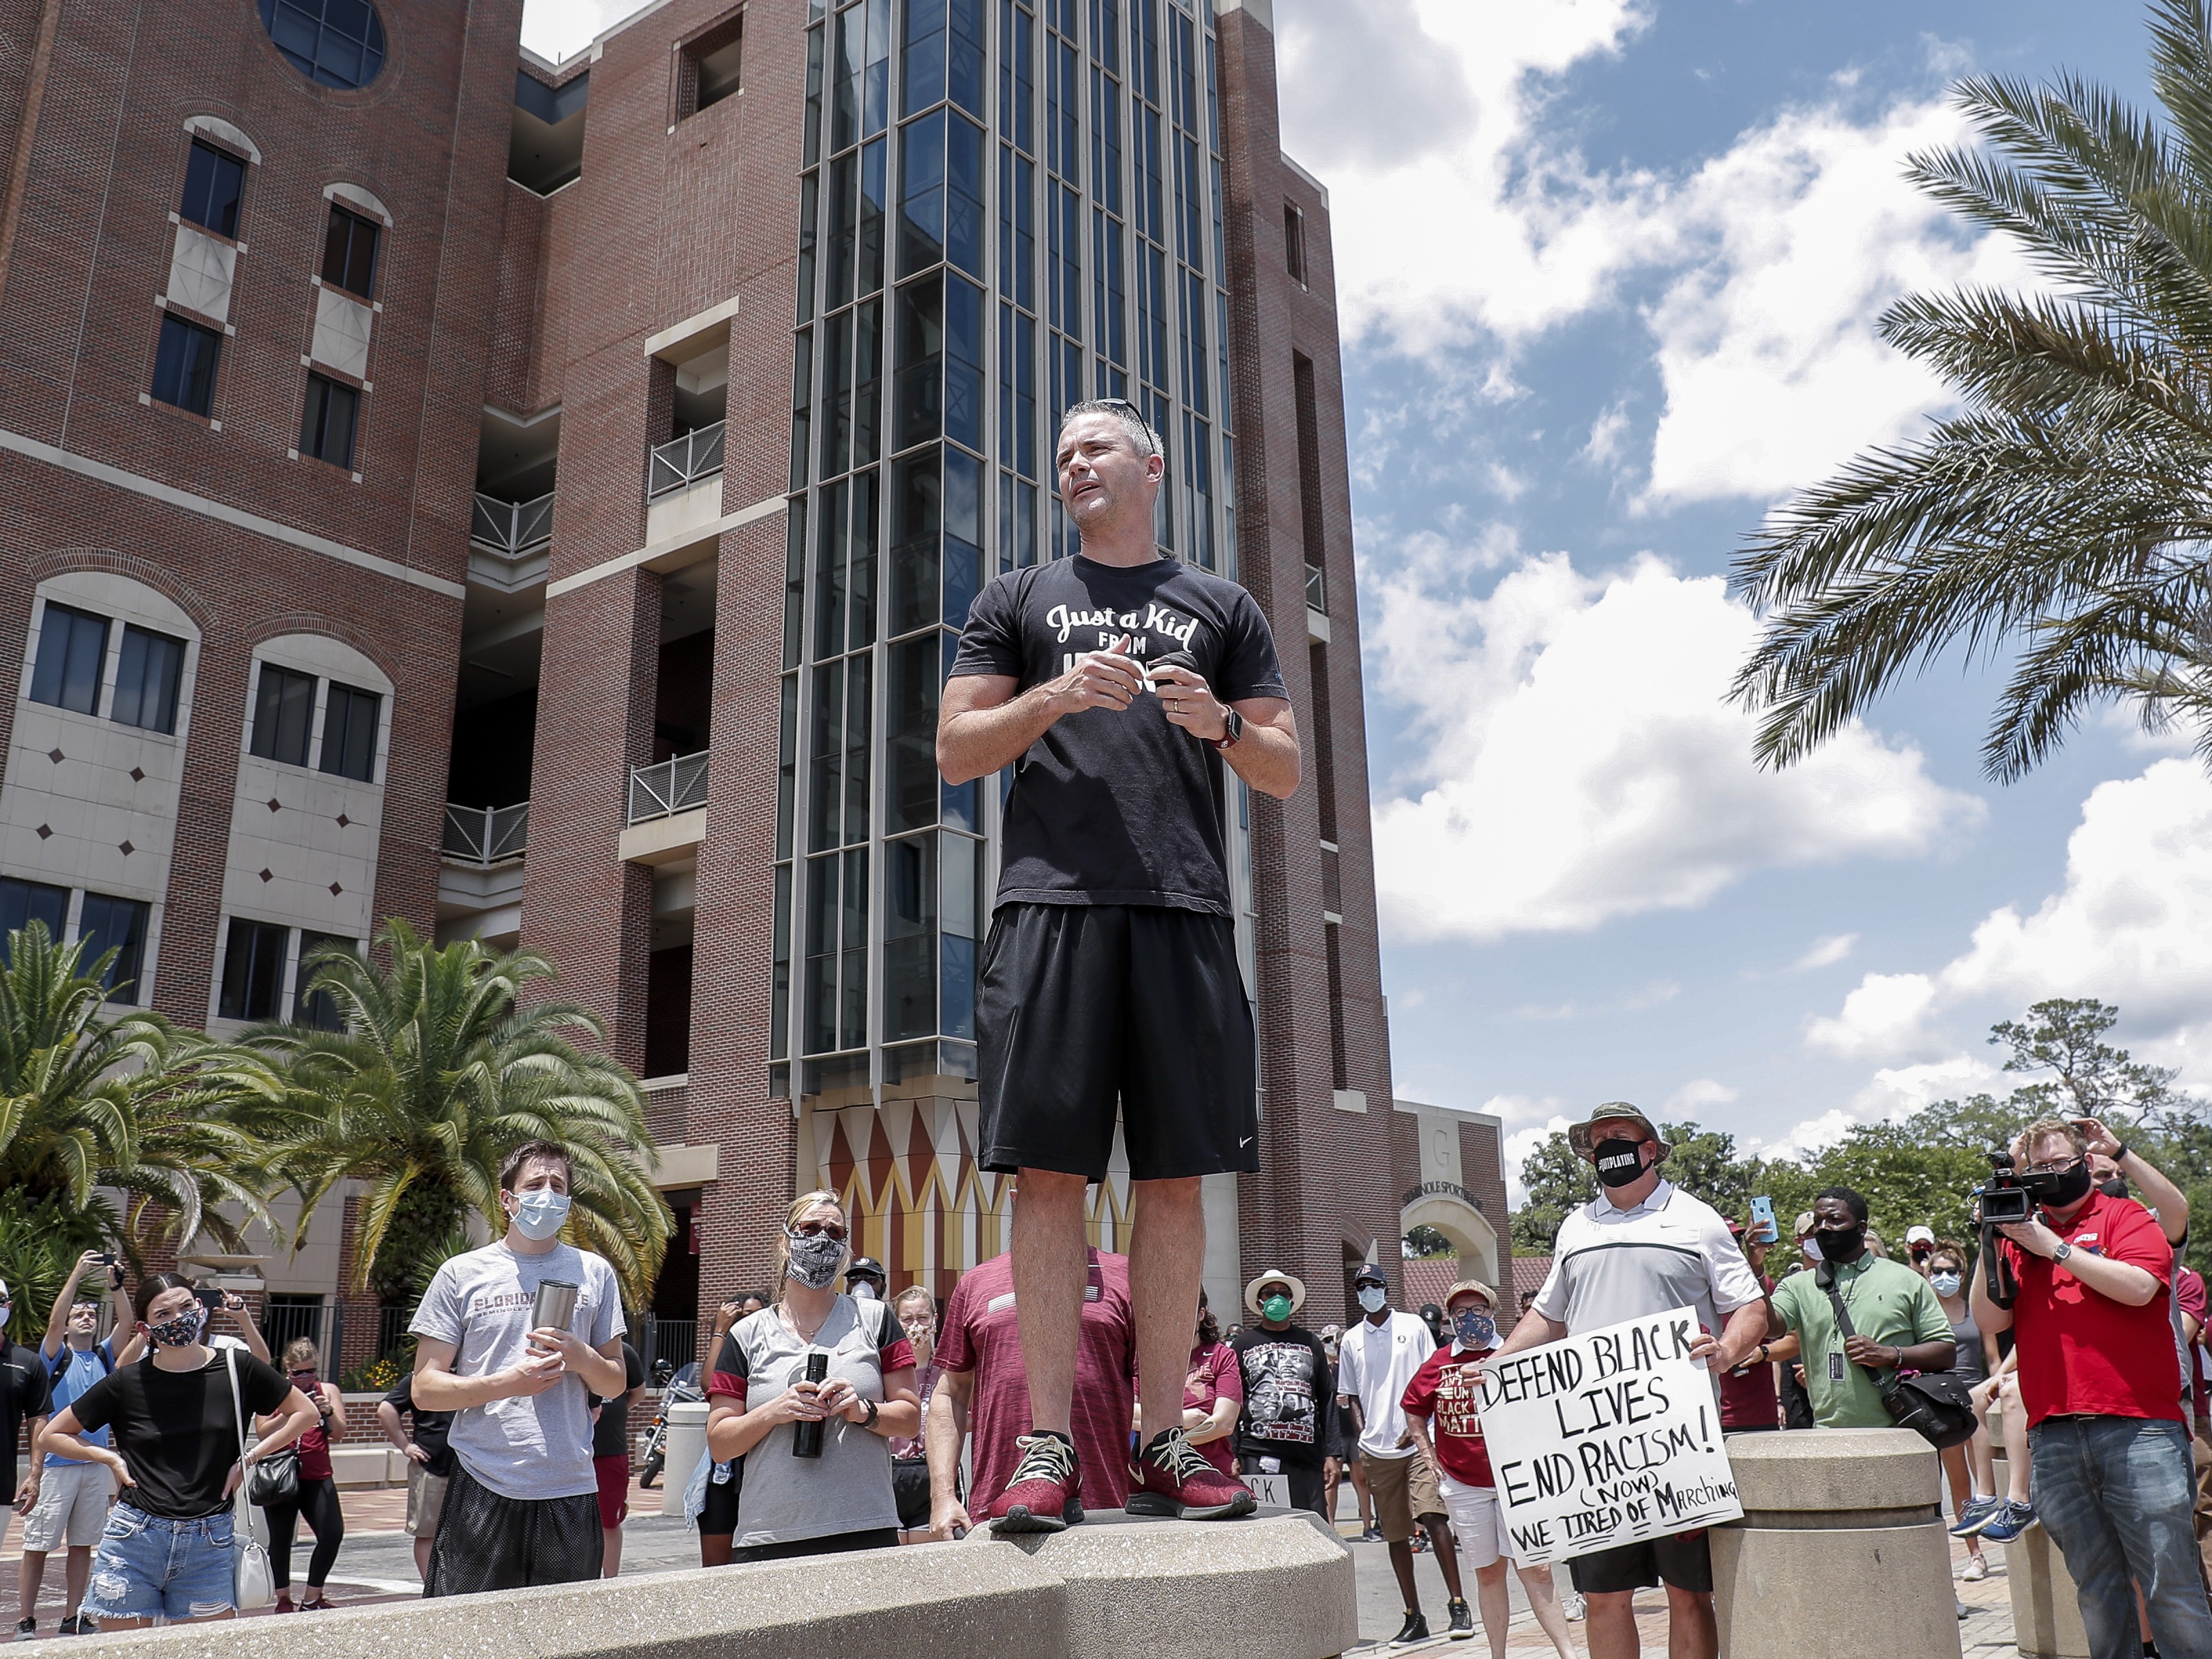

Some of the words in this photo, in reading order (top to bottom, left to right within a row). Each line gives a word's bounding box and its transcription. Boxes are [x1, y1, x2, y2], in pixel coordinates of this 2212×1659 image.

[1046, 603, 1116, 644] Just
[1119, 612, 1141, 630] a
[1142, 603, 1200, 653] Kid
[474, 1291, 537, 1311] FLORIDA
[477, 1306, 523, 1318] SEMINOLE
[1479, 1348, 1583, 1412] DEFEND
[1588, 1320, 1693, 1383] BLACK
[1437, 1400, 1470, 1415] BLACK
[1438, 1414, 1479, 1433] MATT
[1555, 1376, 1670, 1439] LIVES
[1501, 1453, 1575, 1508] END
[1578, 1405, 1715, 1486] RACISM!
[1250, 1477, 1277, 1504] CK
[1580, 1470, 1659, 1507] (NOW)
[1511, 1519, 1556, 1551] WE
[1555, 1506, 1622, 1539] TIRED
[1627, 1497, 1651, 1523] OF
